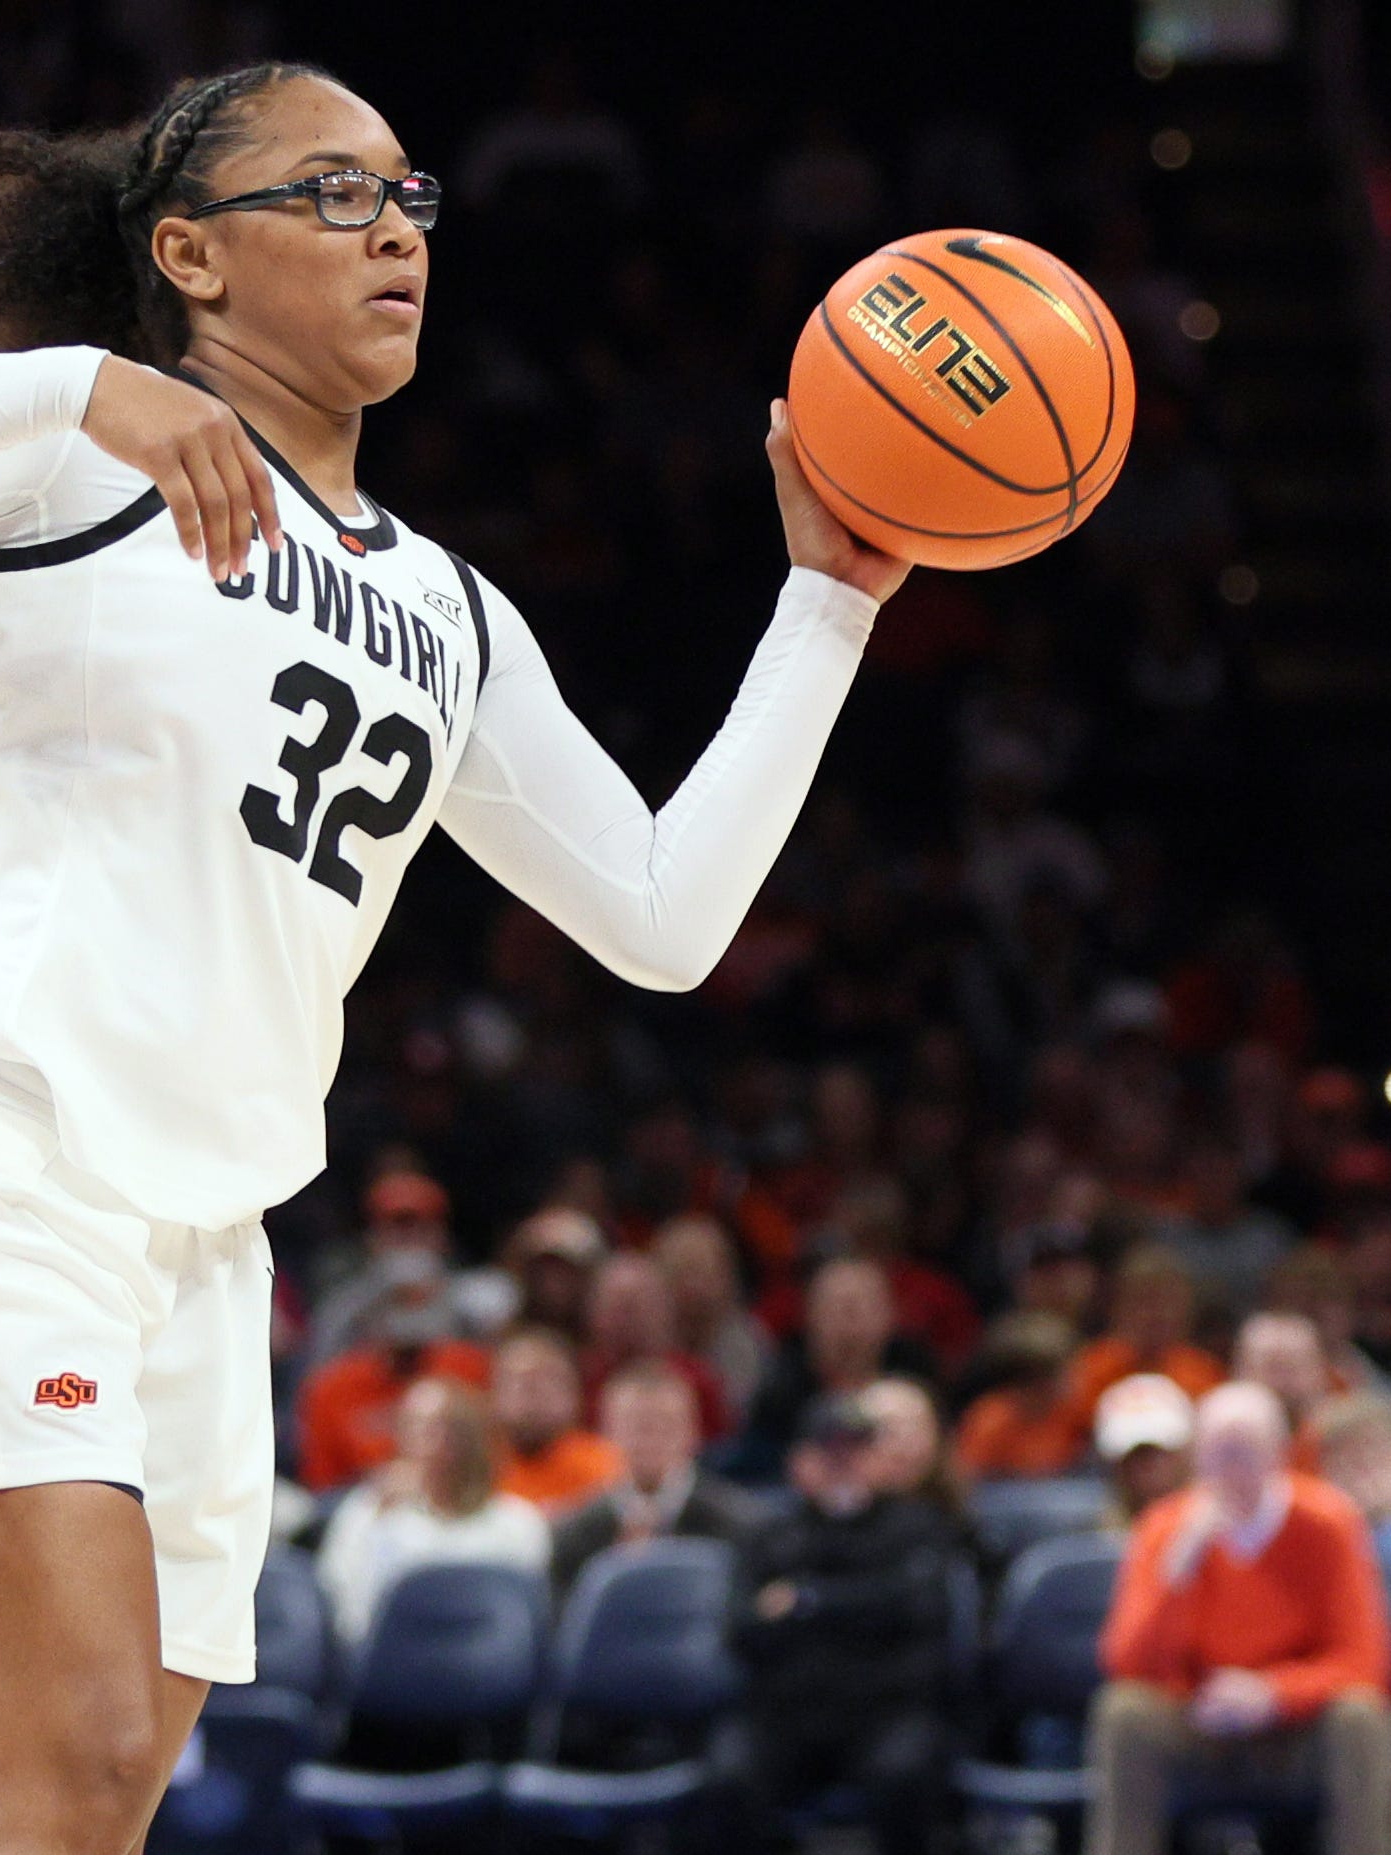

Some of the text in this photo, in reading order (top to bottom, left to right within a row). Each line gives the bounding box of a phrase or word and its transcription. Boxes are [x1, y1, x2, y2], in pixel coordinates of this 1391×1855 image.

[859, 272, 1011, 417] ELITE
[215, 515, 460, 751] OWGIRL
[240, 661, 432, 907] 32
[34, 1372, 97, 1408] OSU
